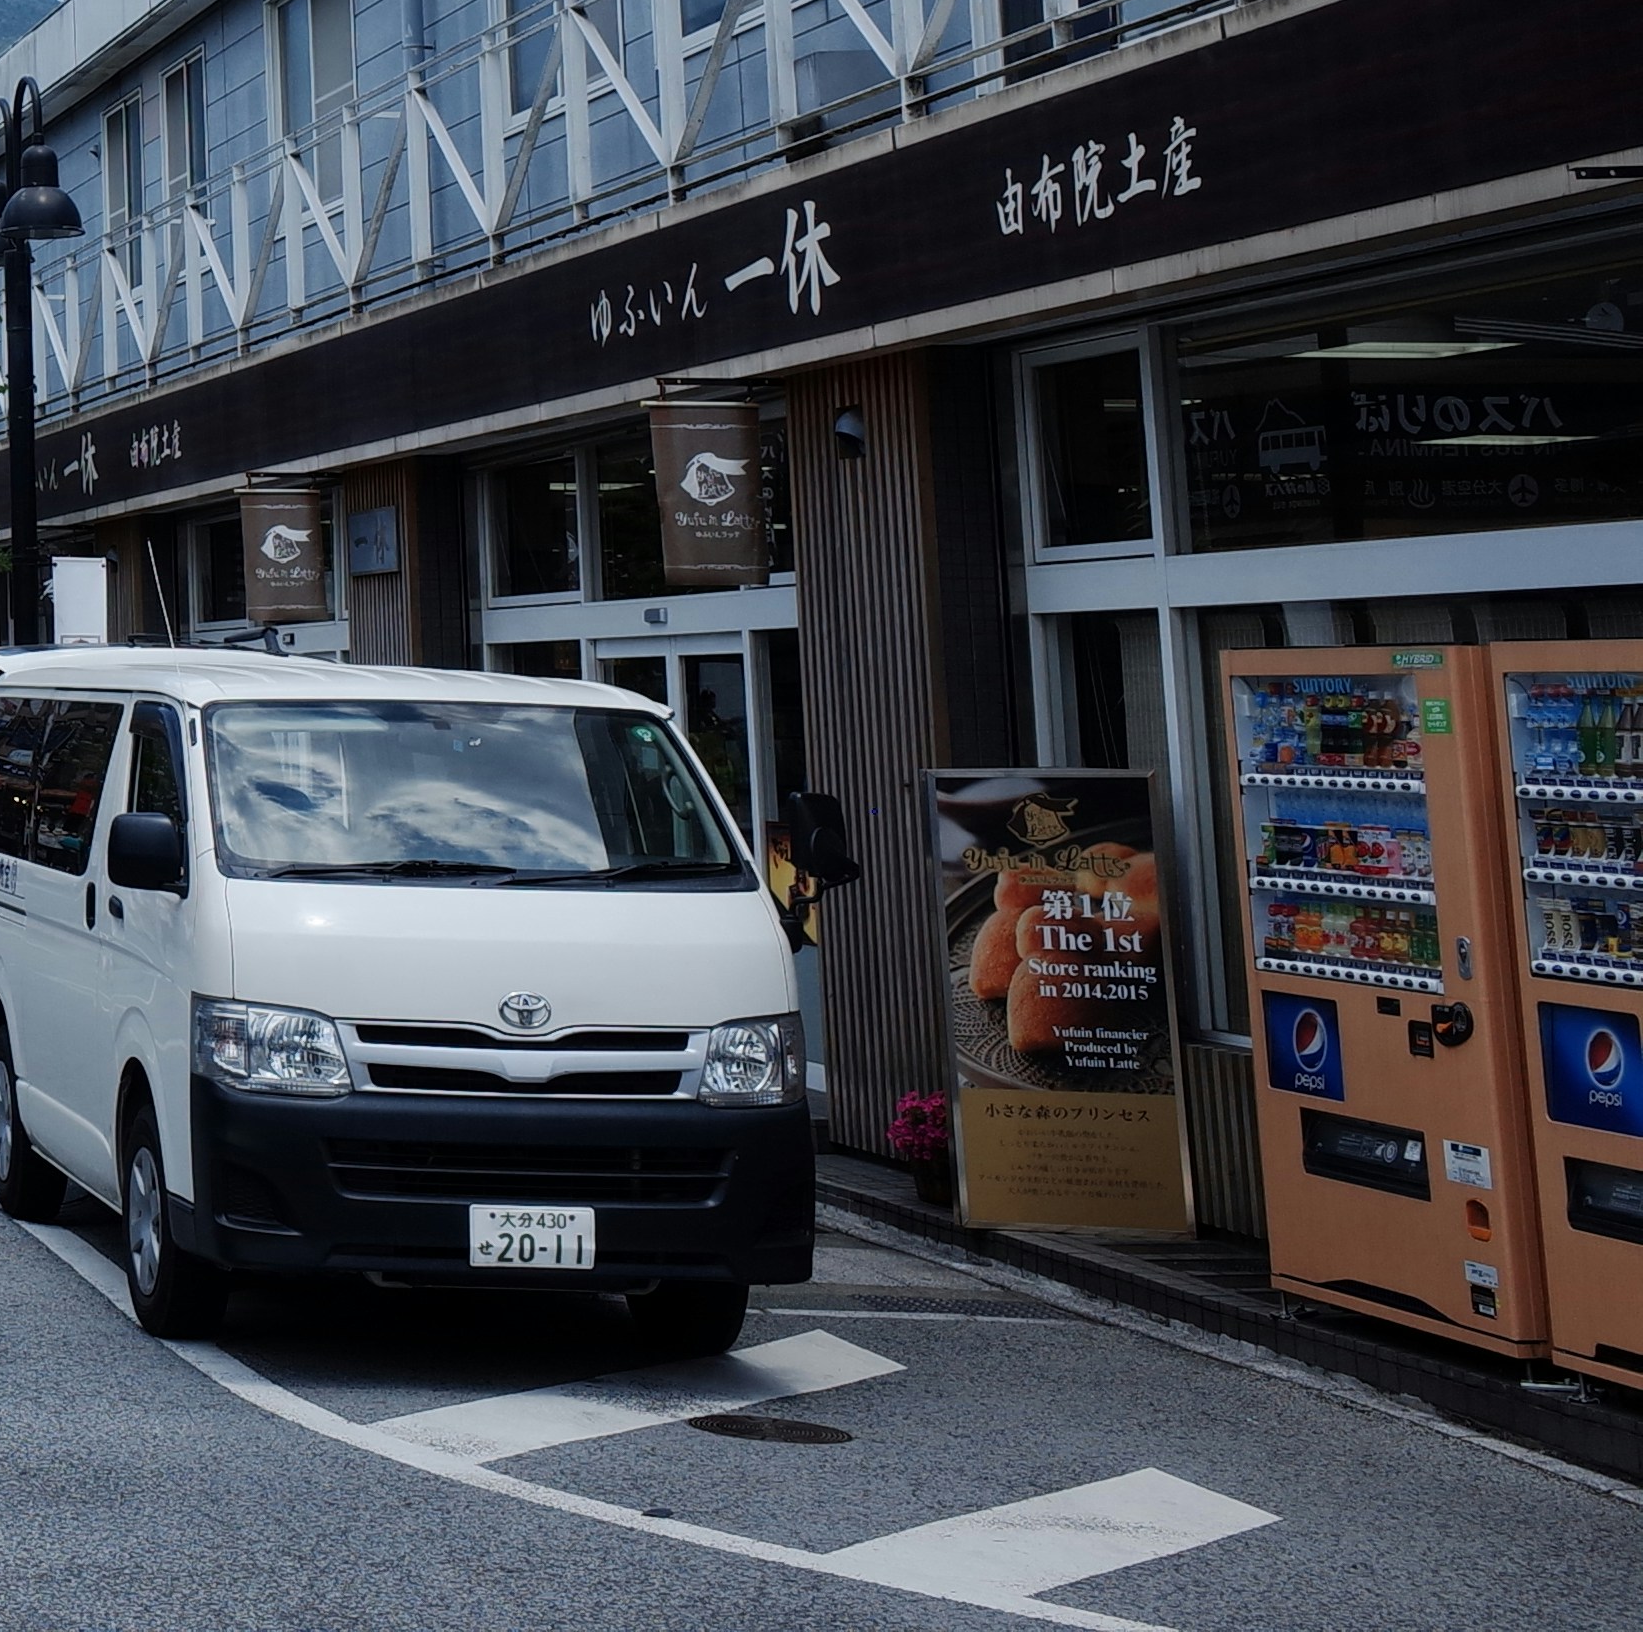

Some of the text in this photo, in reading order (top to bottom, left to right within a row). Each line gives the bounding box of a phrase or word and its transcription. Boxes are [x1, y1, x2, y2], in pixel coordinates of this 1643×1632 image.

[590, 115, 1203, 348] ゆふいん 一休 由布院土産
[63, 431, 100, 496] 一休
[130, 419, 183, 468] 由布院土産
[1401, 654, 1435, 666] HYBRID
[1292, 678, 1352, 694] SUNTORY
[1054, 845, 1131, 878] Latte
[1041, 889, 1135, 922] 第1位
[1035, 925, 1144, 953] The 1st
[1544, 912, 1556, 945] BOSS
[1028, 958, 1157, 984] Store ranking
[1039, 980, 1149, 1001] in 2014,2015
[1052, 1025, 1149, 1041] Yufuin financier
[1064, 1040, 1139, 1057] Produced by
[1065, 1055, 1140, 1069] Yufuin Latte
[1294, 1072, 1325, 1091] pepsi
[1588, 1090, 1622, 1108] pepsi
[985, 1104, 1151, 1123] 小さな森のプリンセス
[477, 1232, 583, 1265] せ 20-11
